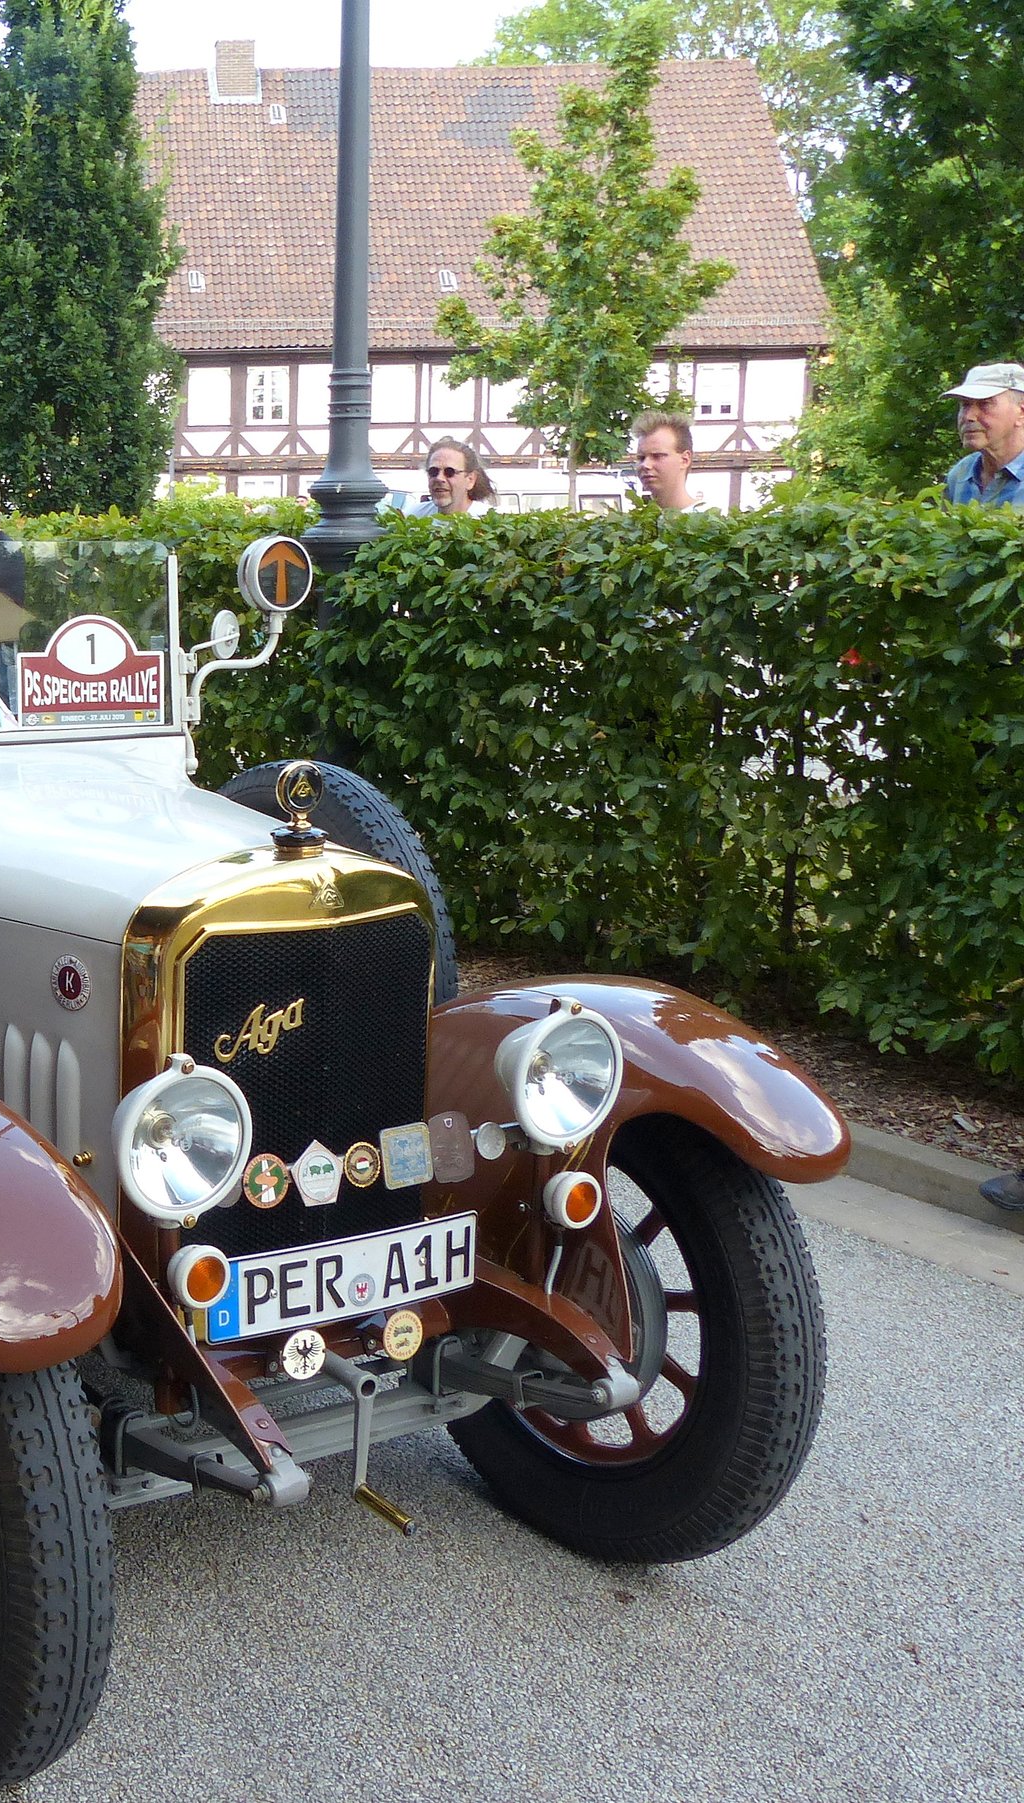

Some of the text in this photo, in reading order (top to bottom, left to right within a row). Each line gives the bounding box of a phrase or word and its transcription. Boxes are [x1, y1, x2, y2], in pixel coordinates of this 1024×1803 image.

[86, 633, 96, 665] 1
[24, 666, 158, 707] PS.SPEICHER RALLYE
[214, 997, 305, 1063] Aga
[218, 1225, 471, 1326] D PER A1H
